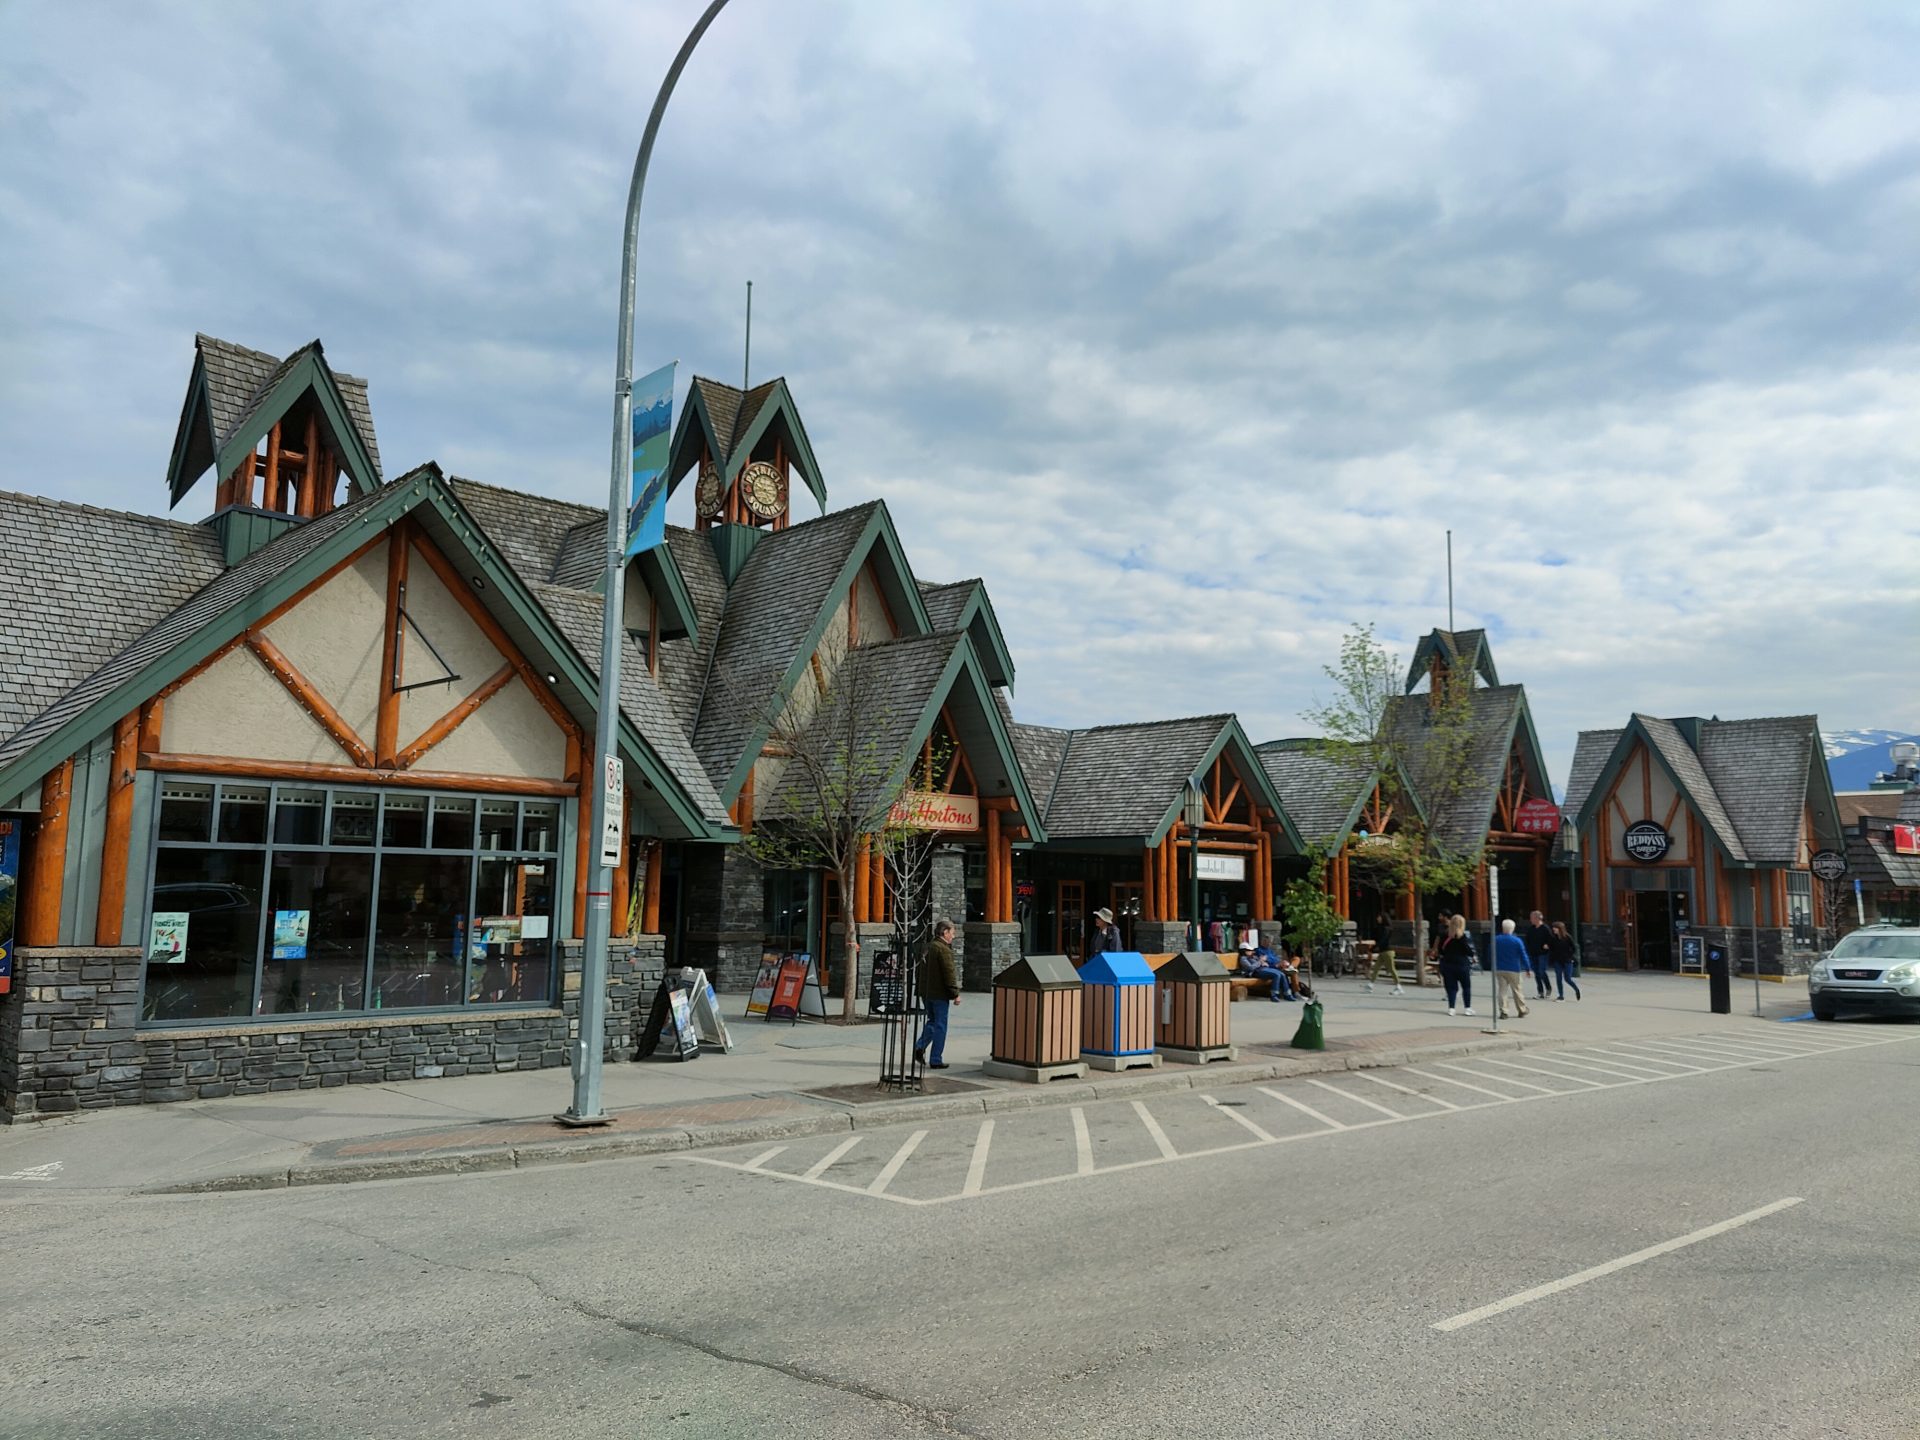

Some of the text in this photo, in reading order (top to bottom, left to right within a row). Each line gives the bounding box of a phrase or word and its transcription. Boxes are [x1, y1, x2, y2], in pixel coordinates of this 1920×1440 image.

[745, 465, 784, 490] PATRICIA
[749, 496, 782, 515] SQUARE
[918, 799, 972, 825] Hortons
[1626, 834, 1666, 848] REDPASS
